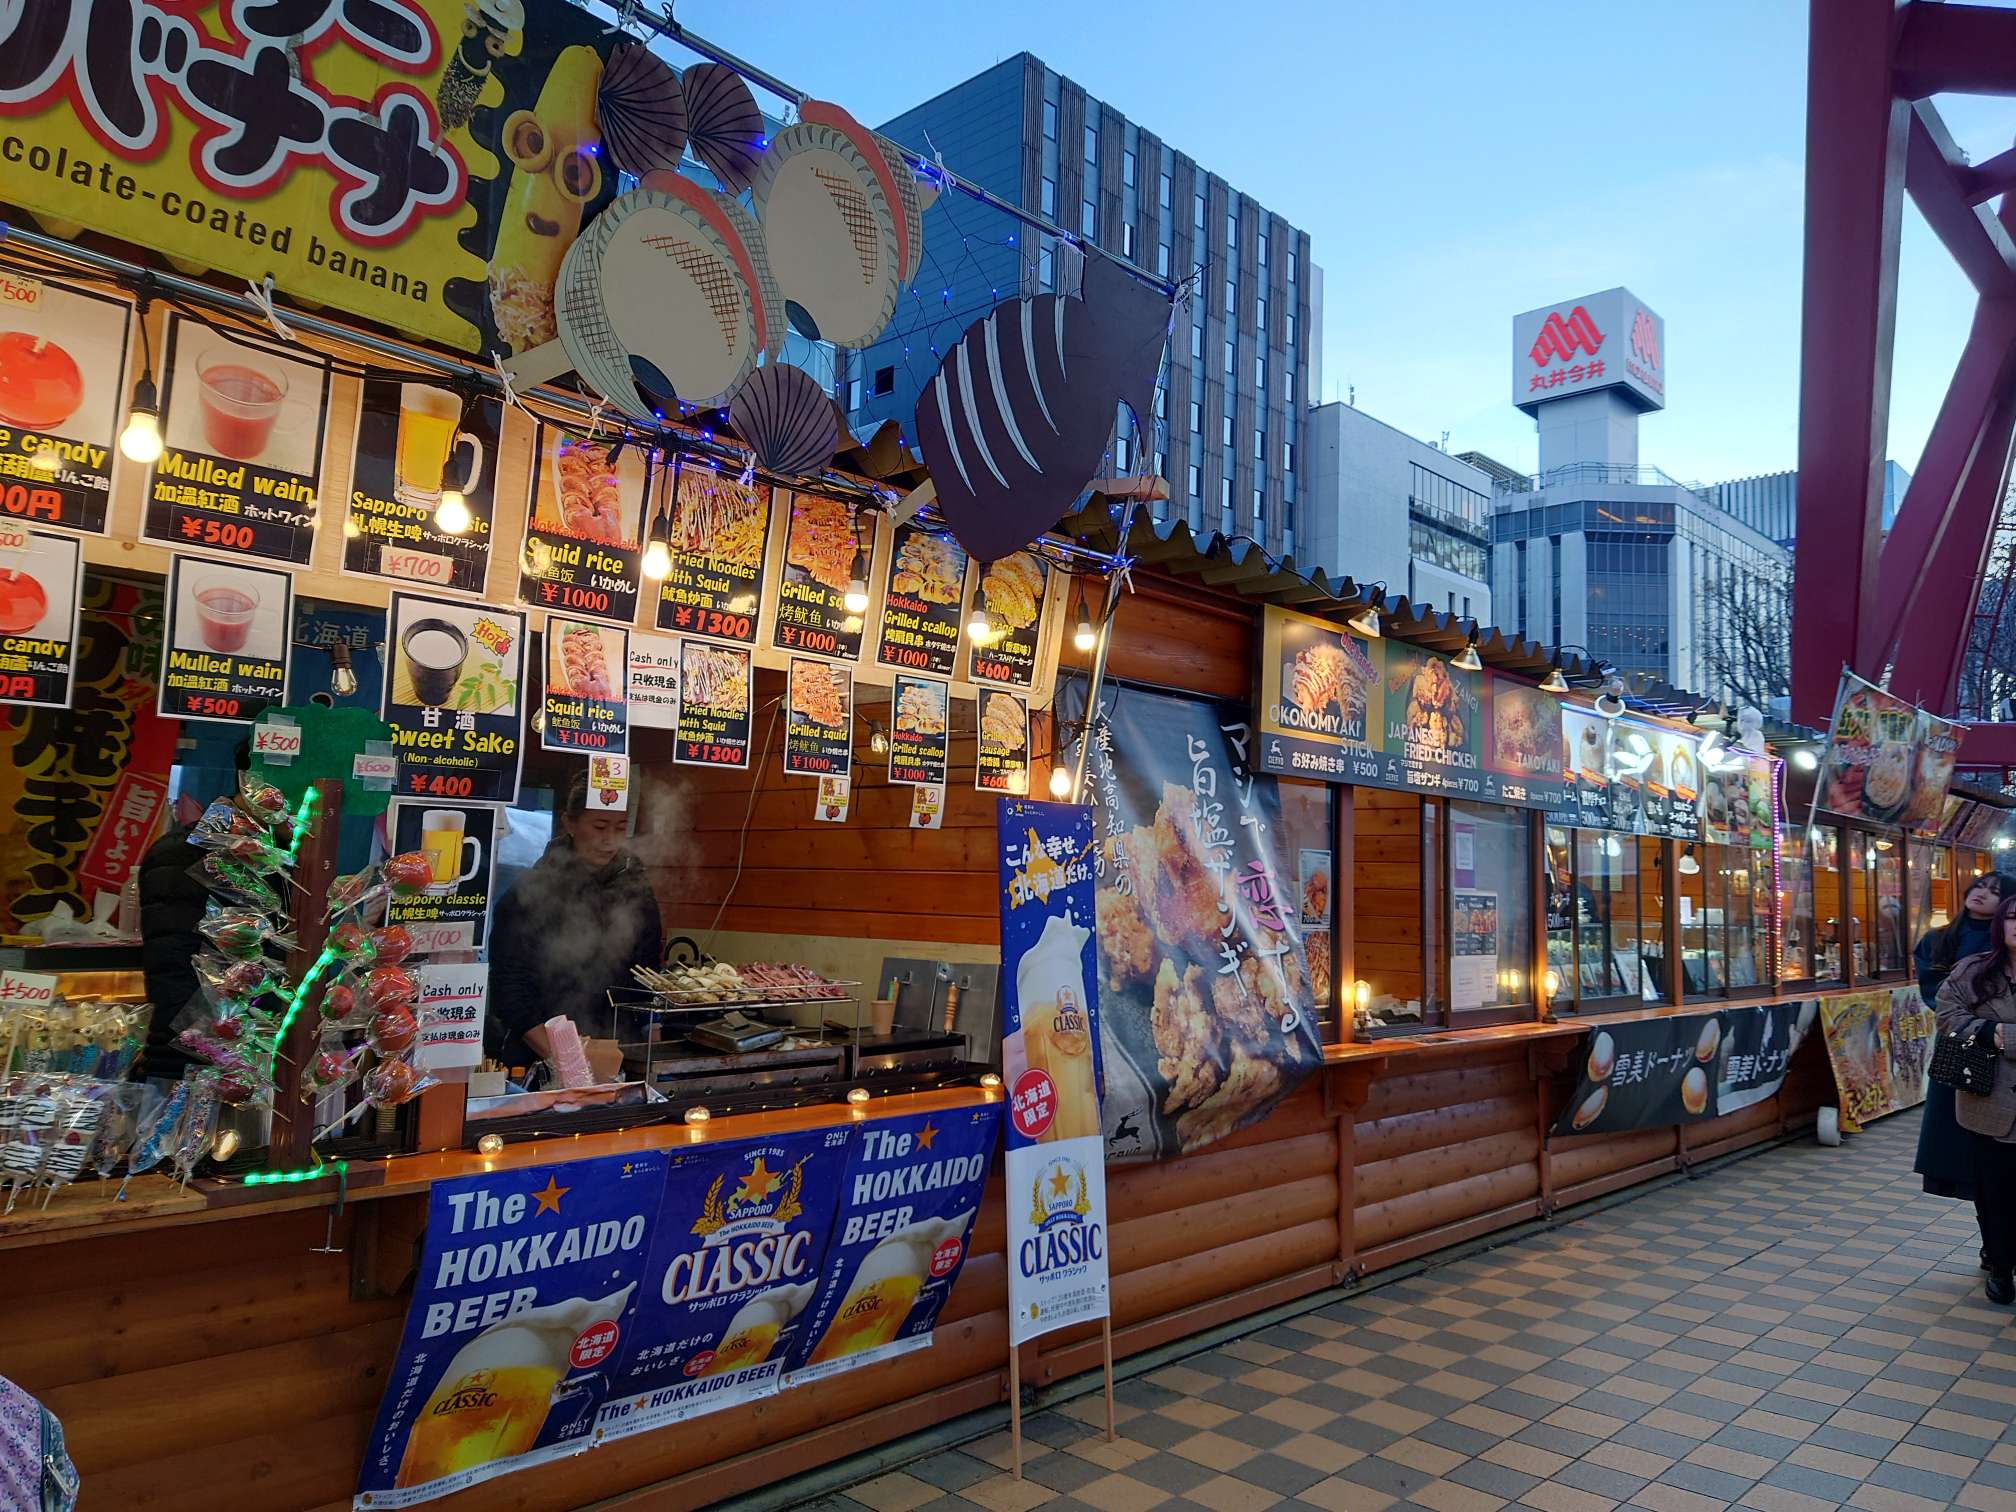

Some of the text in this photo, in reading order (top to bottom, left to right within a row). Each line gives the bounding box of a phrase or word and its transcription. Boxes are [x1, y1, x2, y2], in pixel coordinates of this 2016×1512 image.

[308, 235, 429, 303] banana
[1529, 360, 1606, 392] 丸井今井
[21, 435, 107, 469] candy
[157, 452, 314, 506] Mulled wain
[352, 491, 427, 521] Sapporo
[181, 516, 255, 549] ¥500
[423, 531, 489, 552] サッポロクラシック
[388, 555, 441, 577] ¥700
[586, 551, 623, 574] rice
[671, 549, 756, 580] Fried Noodles
[590, 573, 637, 594] いかめし
[696, 574, 730, 593] Squid
[781, 581, 825, 605] Grilled
[541, 581, 608, 611] ¥1000
[887, 593, 928, 613] Hokkaido
[675, 606, 750, 638] ¥1300
[885, 610, 920, 630] Grilled
[922, 621, 958, 639] scallop
[3, 638, 66, 659] candy
[782, 626, 835, 651] ¥1000
[169, 651, 282, 681] Mulled wain
[629, 651, 679, 668] Cash only
[883, 645, 929, 667] ¥1000
[632, 673, 677, 689] 只收現金
[976, 660, 1010, 680] ¥600
[232, 683, 284, 698] ホットワイン
[1454, 679, 1479, 713] ZANGI
[187, 696, 240, 716] ¥500
[546, 698, 614, 720] Squid rice
[684, 703, 745, 720] Fried Noodles
[591, 721, 625, 734] いかめし
[680, 717, 726, 732] with Squid
[1269, 703, 1361, 738] OKONOMIYAKI
[256, 731, 299, 751] ¥500
[389, 723, 515, 755] Sweet Sake
[559, 730, 606, 748] ¥1000
[789, 723, 848, 741] Grilled squid
[893, 730, 923, 742] Hokkaido
[1388, 720, 1444, 747] JAPANESE
[688, 743, 742, 763] ¥1300
[892, 742, 944, 759] Grilled scallop
[1341, 736, 1375, 760] STICK
[1403, 741, 1477, 769] FRIED CHICKEN
[356, 760, 392, 773] ¥600
[403, 752, 479, 768] (Non-alcoholic)
[612, 762, 621, 776] 3
[791, 754, 830, 771] ¥1000
[1292, 751, 1345, 774] お好み焼き串
[1353, 760, 1378, 778] ¥500
[1516, 752, 1561, 774] TAKOYAKI
[410, 774, 472, 797] ¥400
[893, 768, 925, 781] ¥1000
[1407, 771, 1441, 788] 旨塩ザンギ
[1458, 779, 1479, 793] ¥700
[1502, 785, 1527, 800] たこ焼き
[928, 792, 936, 803] 2
[1186, 733, 1248, 997] 旨塩ザンギ
[446, 893, 486, 905] classic
[1, 976, 50, 1000] ¥500
[423, 982, 484, 997] Cash only
[1053, 1013, 1085, 1033] CLASSIC
[1012, 1078, 1052, 1112] 北海道
[1023, 1103, 1050, 1128] 限定
[826, 1131, 849, 1141] ONLY
[862, 1129, 912, 1162] The
[744, 1148, 766, 1160] SINCE
[852, 1153, 984, 1206] HOKKAIDO
[448, 1190, 527, 1234] The
[729, 1203, 773, 1219] SAPPORO
[1048, 1200, 1073, 1211] SAPPORO
[731, 1222, 760, 1233] HOKKAIDO
[761, 1221, 774, 1229] BEER
[841, 1205, 914, 1247] BEER
[433, 1215, 646, 1289] HOKKAIDO
[1020, 1223, 1103, 1279] CLASSIC
[662, 1231, 812, 1305] CLASSIC
[1039, 1265, 1087, 1284] サッポロ クラシック
[688, 1284, 772, 1313] サッポロ クラシック
[420, 1287, 538, 1339] BEER
[576, 1330, 615, 1350] 北海道
[637, 1332, 714, 1361] 北海道だけの
[578, 1346, 605, 1361] 限定
[433, 1392, 499, 1415] CLASSIC
[599, 1401, 630, 1422] The
[650, 1373, 735, 1408] HOKKAIDO
[737, 1363, 777, 1385] BEER
[560, 1418, 591, 1432] ONLY
